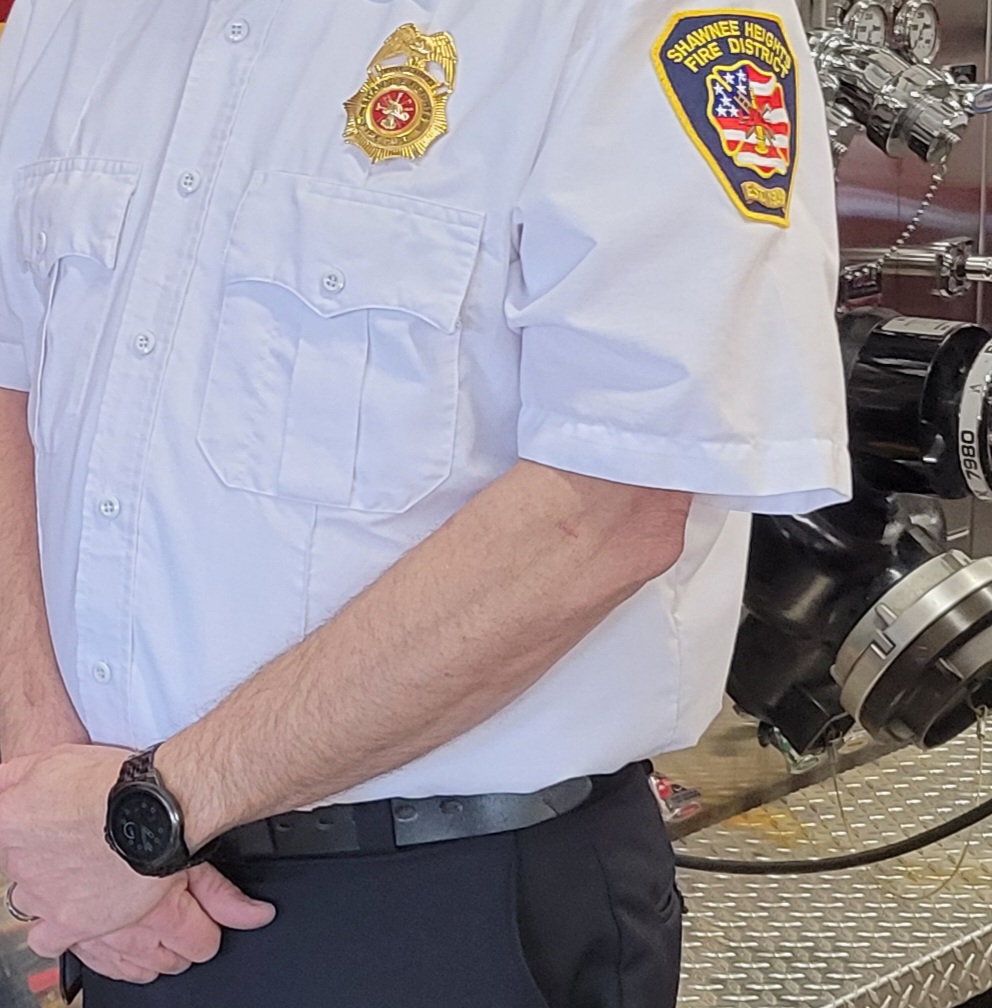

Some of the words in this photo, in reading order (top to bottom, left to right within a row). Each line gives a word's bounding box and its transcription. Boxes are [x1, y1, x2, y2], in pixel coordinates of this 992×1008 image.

[666, 19, 741, 63] SHAWNEE
[683, 41, 724, 73] FIRE
[727, 37, 789, 79] DISTRICT
[961, 430, 982, 480] 7980
